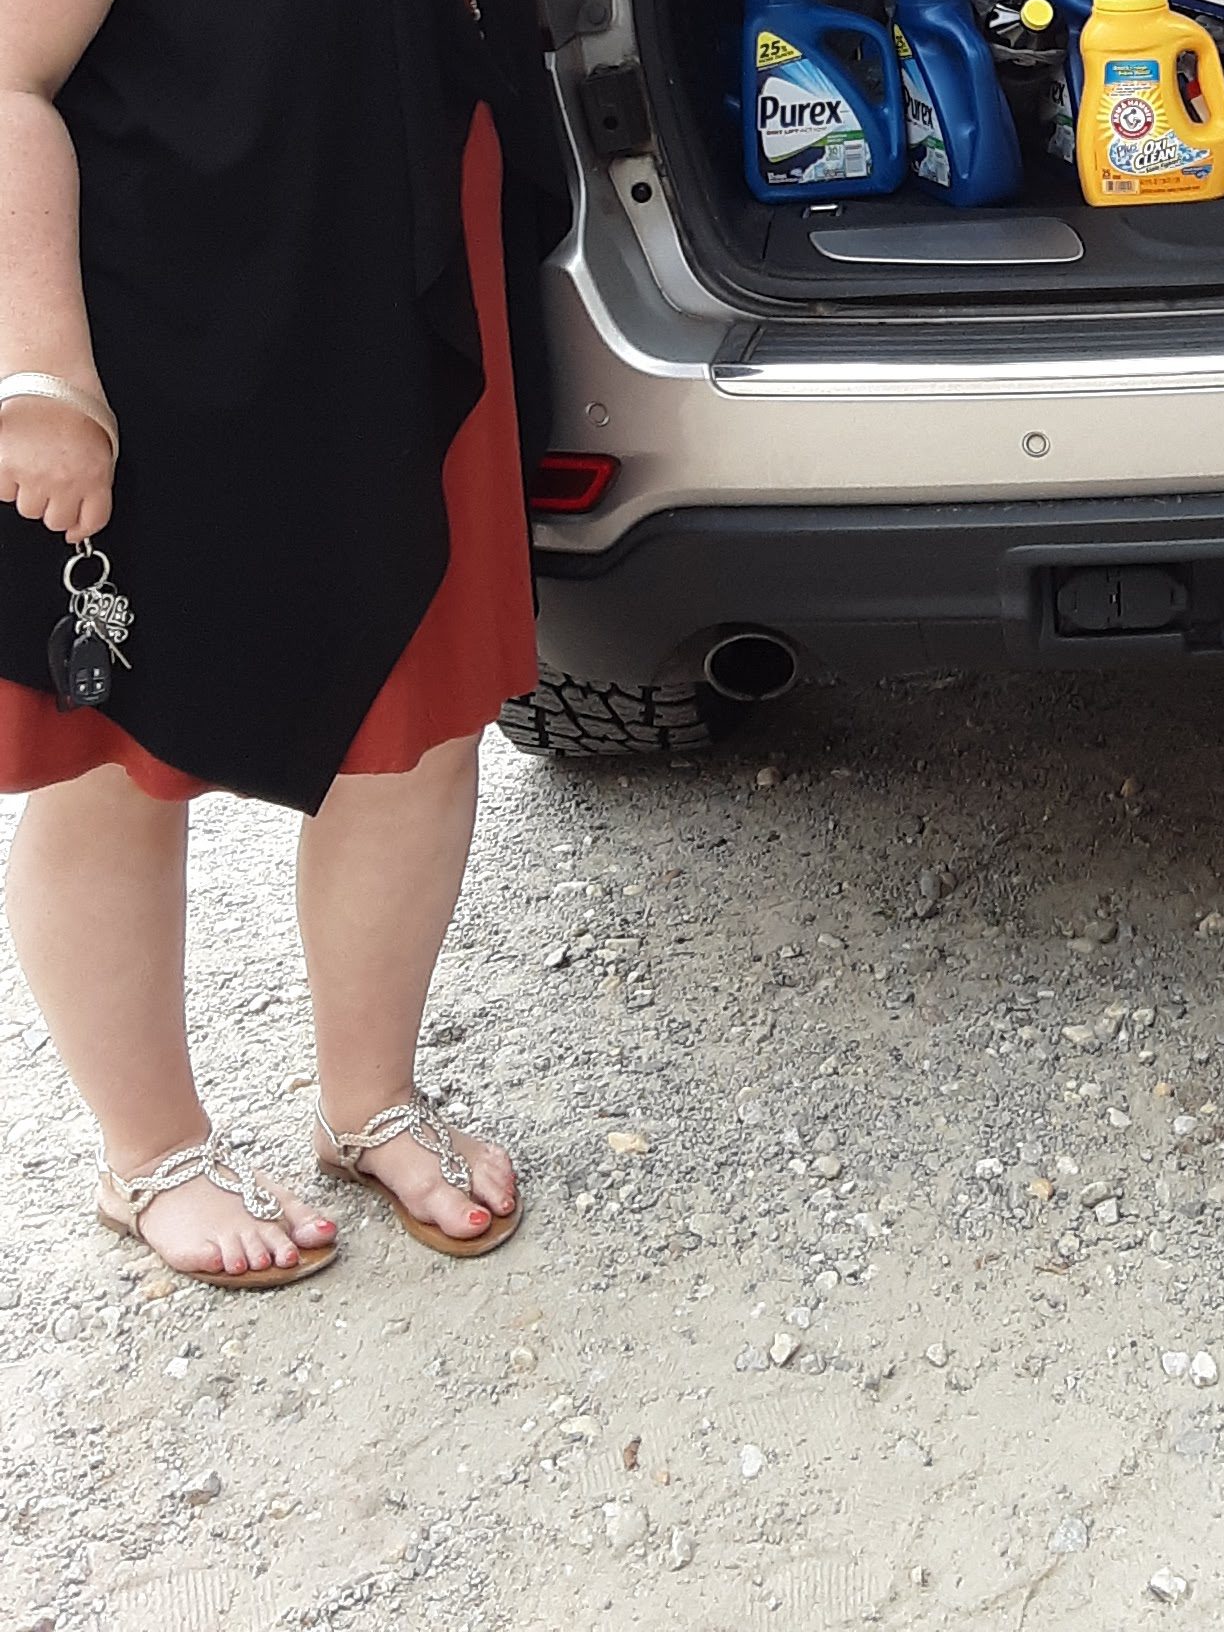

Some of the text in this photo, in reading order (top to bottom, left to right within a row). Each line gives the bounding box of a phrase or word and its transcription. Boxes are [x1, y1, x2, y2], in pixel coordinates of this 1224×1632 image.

[759, 95, 843, 129] Purex
[903, 87, 933, 128] Purex
[1116, 143, 1139, 159] Plus
[1134, 145, 1177, 170] CLEAN
[1143, 137, 1168, 154] OXI
